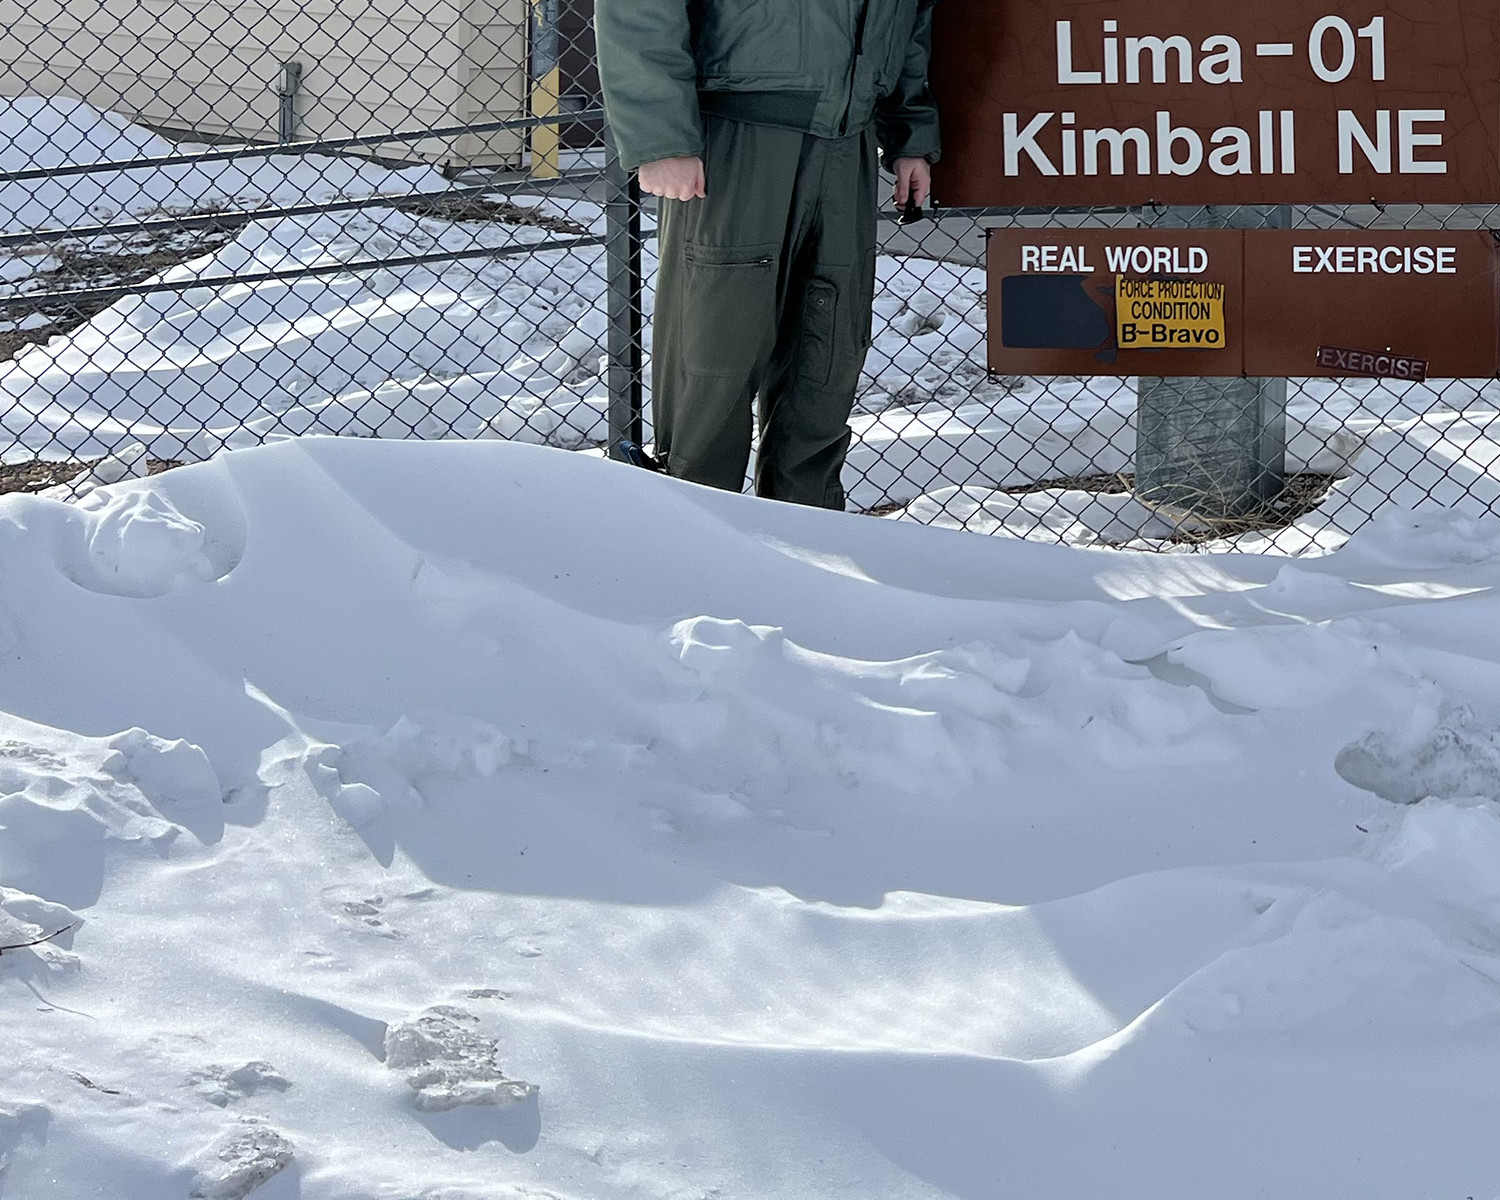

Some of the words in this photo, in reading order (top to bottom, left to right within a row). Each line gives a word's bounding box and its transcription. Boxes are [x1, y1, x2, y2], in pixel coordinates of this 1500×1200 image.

[1002, 110, 1296, 177] Kimball
[1337, 109, 1447, 174] NE
[1021, 245, 1095, 272] REAL
[1104, 245, 1209, 274] WORLD
[1292, 246, 1457, 274] EXERCISE
[1119, 280, 1155, 298] FORCE
[1158, 281, 1221, 301] PROTECTION
[1131, 301, 1210, 320] CONDITION
[1121, 323, 1219, 344] B-Bravo
[1321, 348, 1424, 378] EXERCISE
